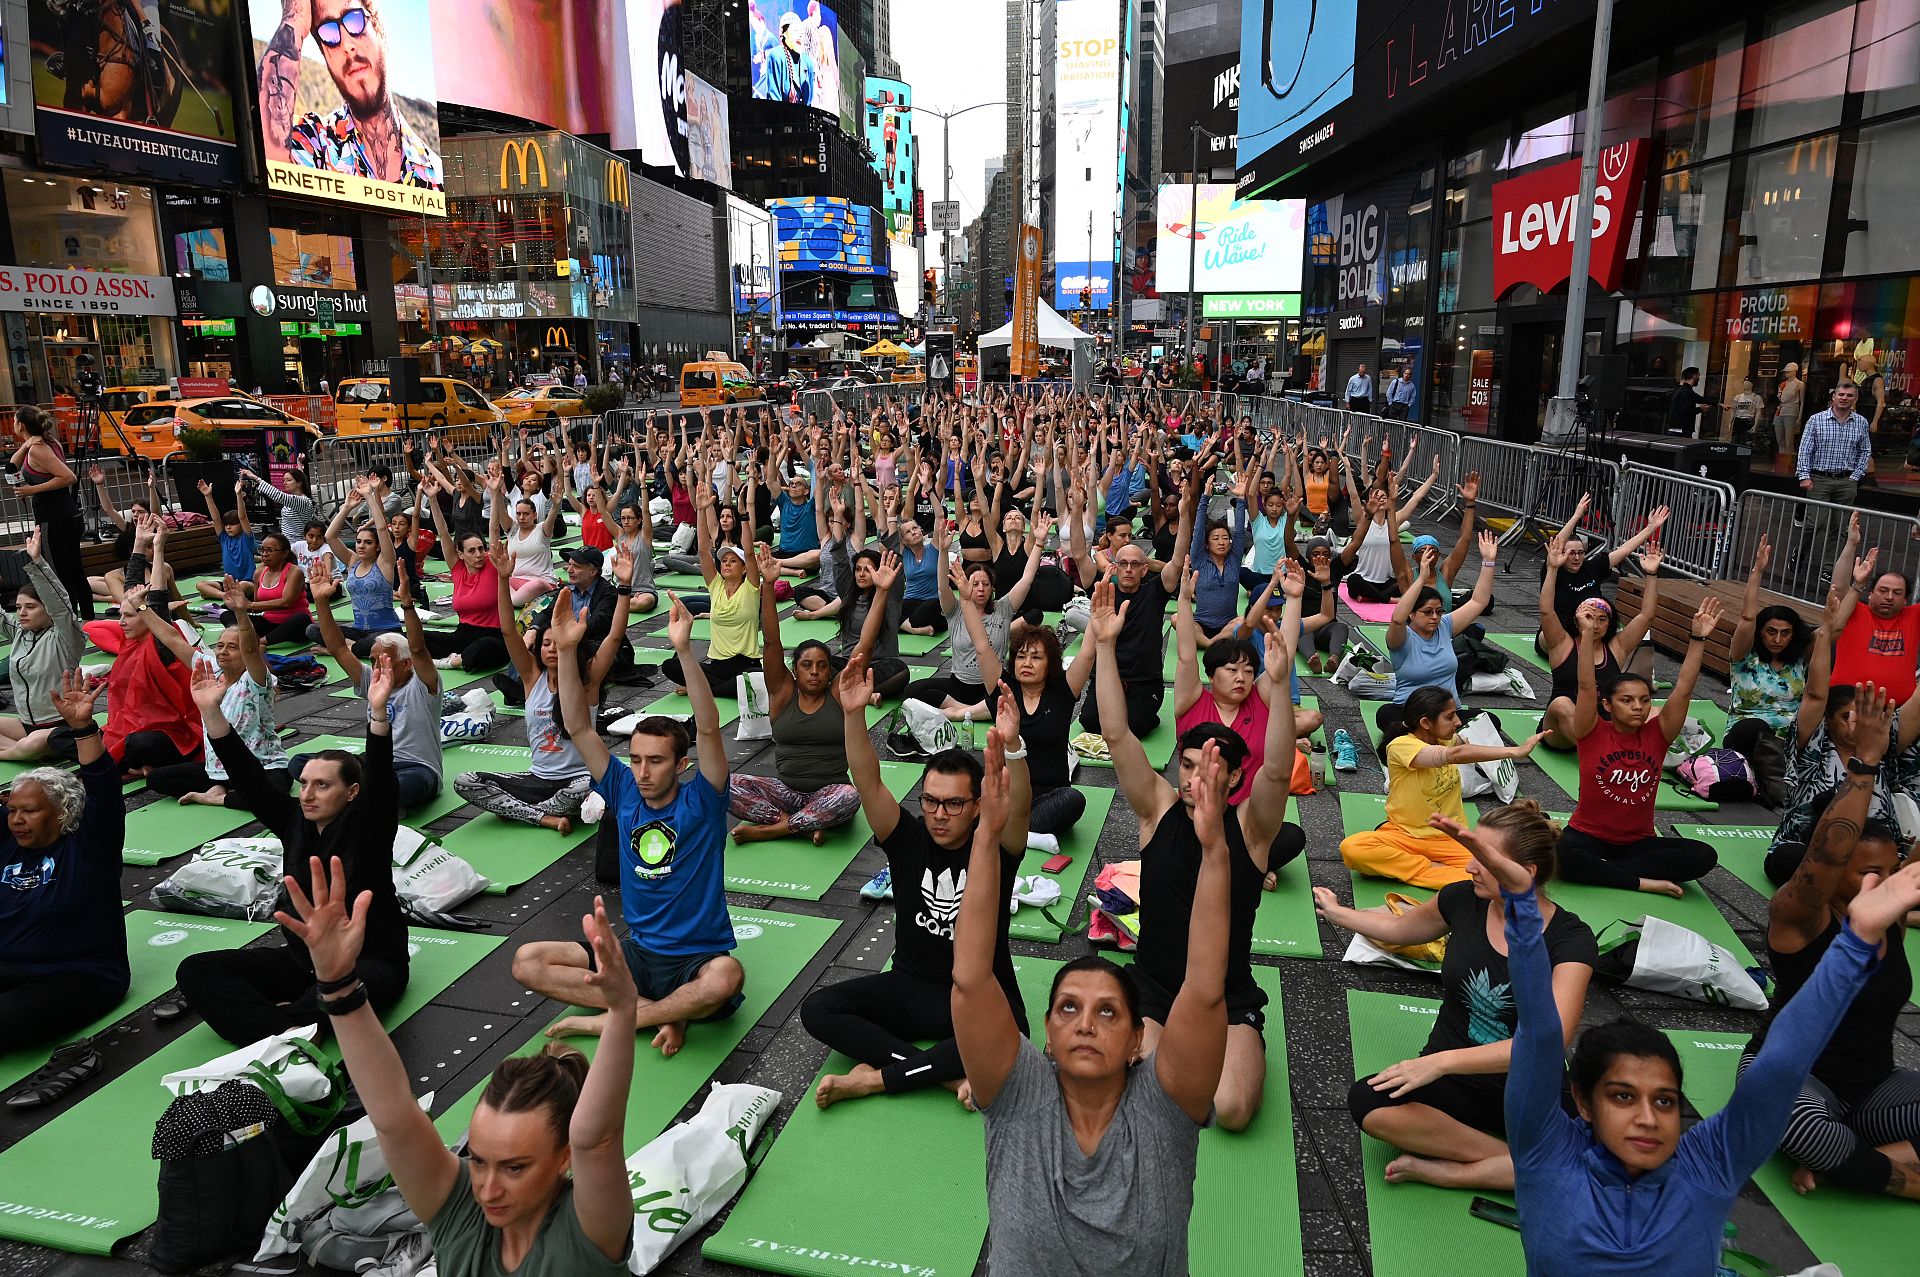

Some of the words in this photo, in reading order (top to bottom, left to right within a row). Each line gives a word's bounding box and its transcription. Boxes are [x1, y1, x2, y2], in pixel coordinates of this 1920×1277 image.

[1060, 38, 1117, 58] STOP
[1065, 60, 1111, 70] SHAVING
[1061, 71, 1115, 81] IRRITATION
[66, 126, 219, 166] #LIVEAUTHENTICALLY
[1210, 135, 1227, 151] NEW
[1299, 133, 1314, 154] SWISS
[1314, 125, 1331, 142] MADE
[818, 132, 827, 173] 1500
[363, 185, 406, 203] POST
[1218, 221, 1257, 247] Ride
[1340, 204, 1379, 266] BIG
[1204, 242, 1267, 270] Wave!
[23, 272, 89, 296] POLO
[94, 277, 156, 299] ASSN.
[1338, 262, 1377, 301] BOLD
[23, 298, 74, 309] SINCE
[81, 300, 119, 311] 1890
[344, 291, 369, 313] hut
[1208, 299, 1243, 312] NEW
[1245, 299, 1286, 312] YORK
[1739, 294, 1790, 314] PROUD.
[1339, 314, 1361, 330] swatch
[1725, 315, 1801, 335] TOGETHER.
[1472, 378, 1489, 388] SALE
[1595, 774, 1637, 805] ORIGINAL
[1609, 768, 1651, 793] nyc
